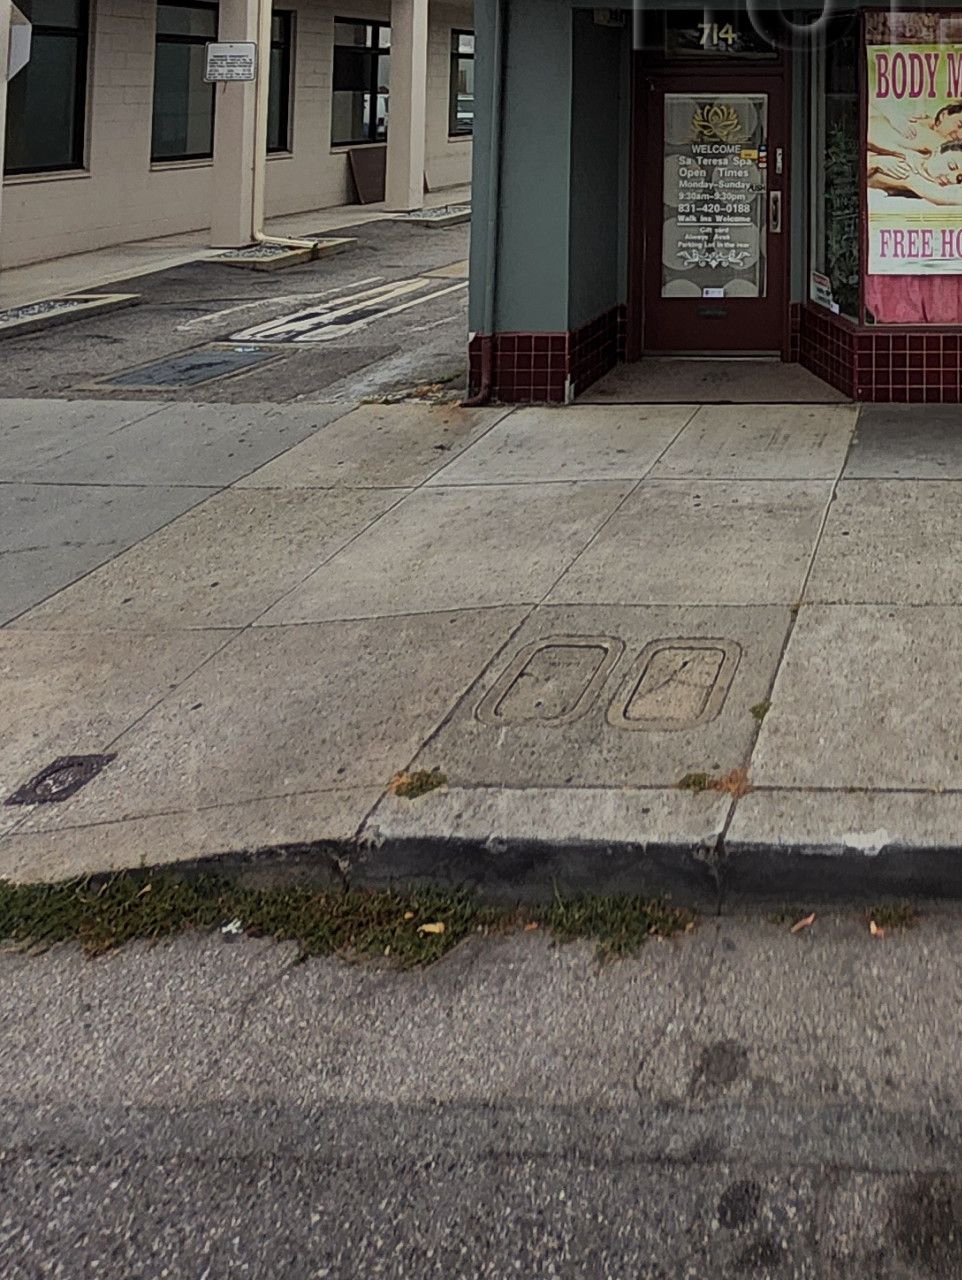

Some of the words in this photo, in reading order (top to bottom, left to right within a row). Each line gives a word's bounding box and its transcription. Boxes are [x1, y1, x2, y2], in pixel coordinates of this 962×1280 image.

[697, 23, 738, 45] 714
[875, 52, 940, 99] BODY
[691, 144, 742, 154] WELCOME
[679, 156, 692, 165] Sa
[696, 156, 729, 165] Teresa
[732, 156, 753, 166] Spa
[679, 168, 707, 178] Open
[718, 168, 749, 177] Times
[678, 204, 751, 213] 831-420-0188
[880, 229, 934, 258] FREE
